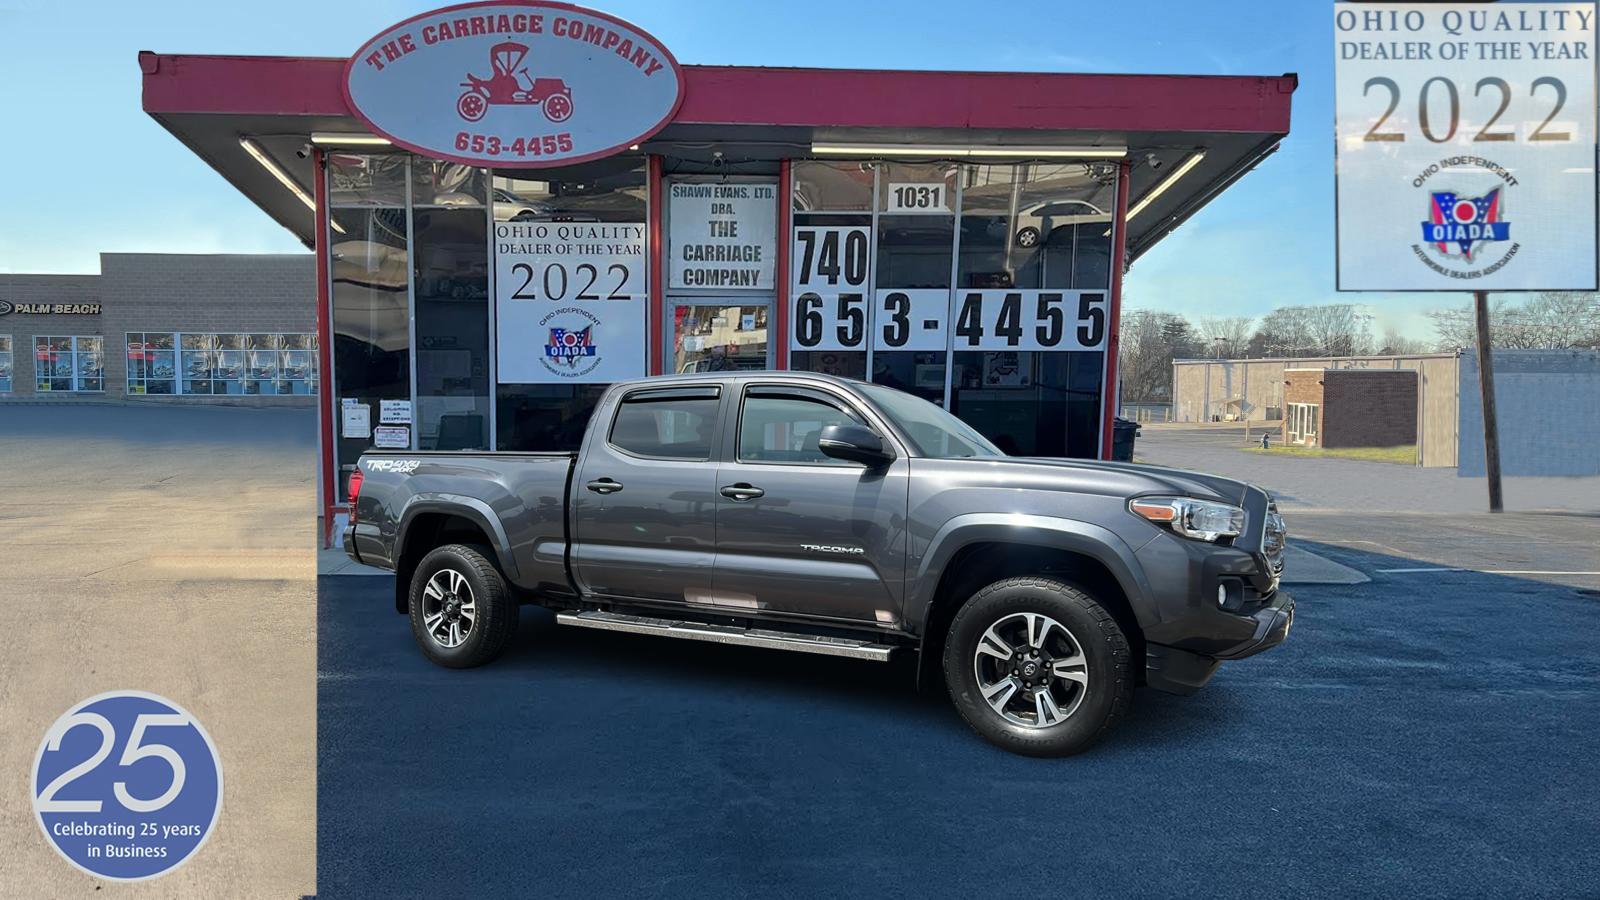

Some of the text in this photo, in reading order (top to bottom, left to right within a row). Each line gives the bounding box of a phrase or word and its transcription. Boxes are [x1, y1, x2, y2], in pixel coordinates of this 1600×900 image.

[1336, 10, 1593, 35] OHIO QUALITY
[366, 14, 664, 77] THE CARRIAGE COMPANY
[1340, 41, 1589, 60] DEALER OF THE YEAR
[1362, 76, 1571, 143] 2022
[454, 132, 573, 156] 653-4455
[1412, 155, 1519, 188] OHIO INDEPENDENT
[672, 186, 712, 198] SHAWN
[754, 187, 775, 199] LTD.
[894, 186, 941, 209] 1031
[711, 203, 736, 215] DBA.
[497, 226, 644, 241] OHIO QUALITY
[708, 220, 738, 238] THE
[1432, 224, 1495, 241] OIADA
[499, 243, 642, 256] DEALER OF THE YEAR
[683, 244, 762, 263] CARRIAGE
[797, 230, 868, 287] 740
[1411, 242, 1521, 280] AUTOMOBILE DEALERS ASSOCIATION
[511, 262, 632, 301] 2022
[683, 268, 761, 287] COMPANY
[14, 303, 101, 314] PALM BEACH
[539, 307, 601, 326] OHIO INDEPENDENT
[551, 346, 588, 356] OIADA
[800, 544, 864, 554] TACOMA
